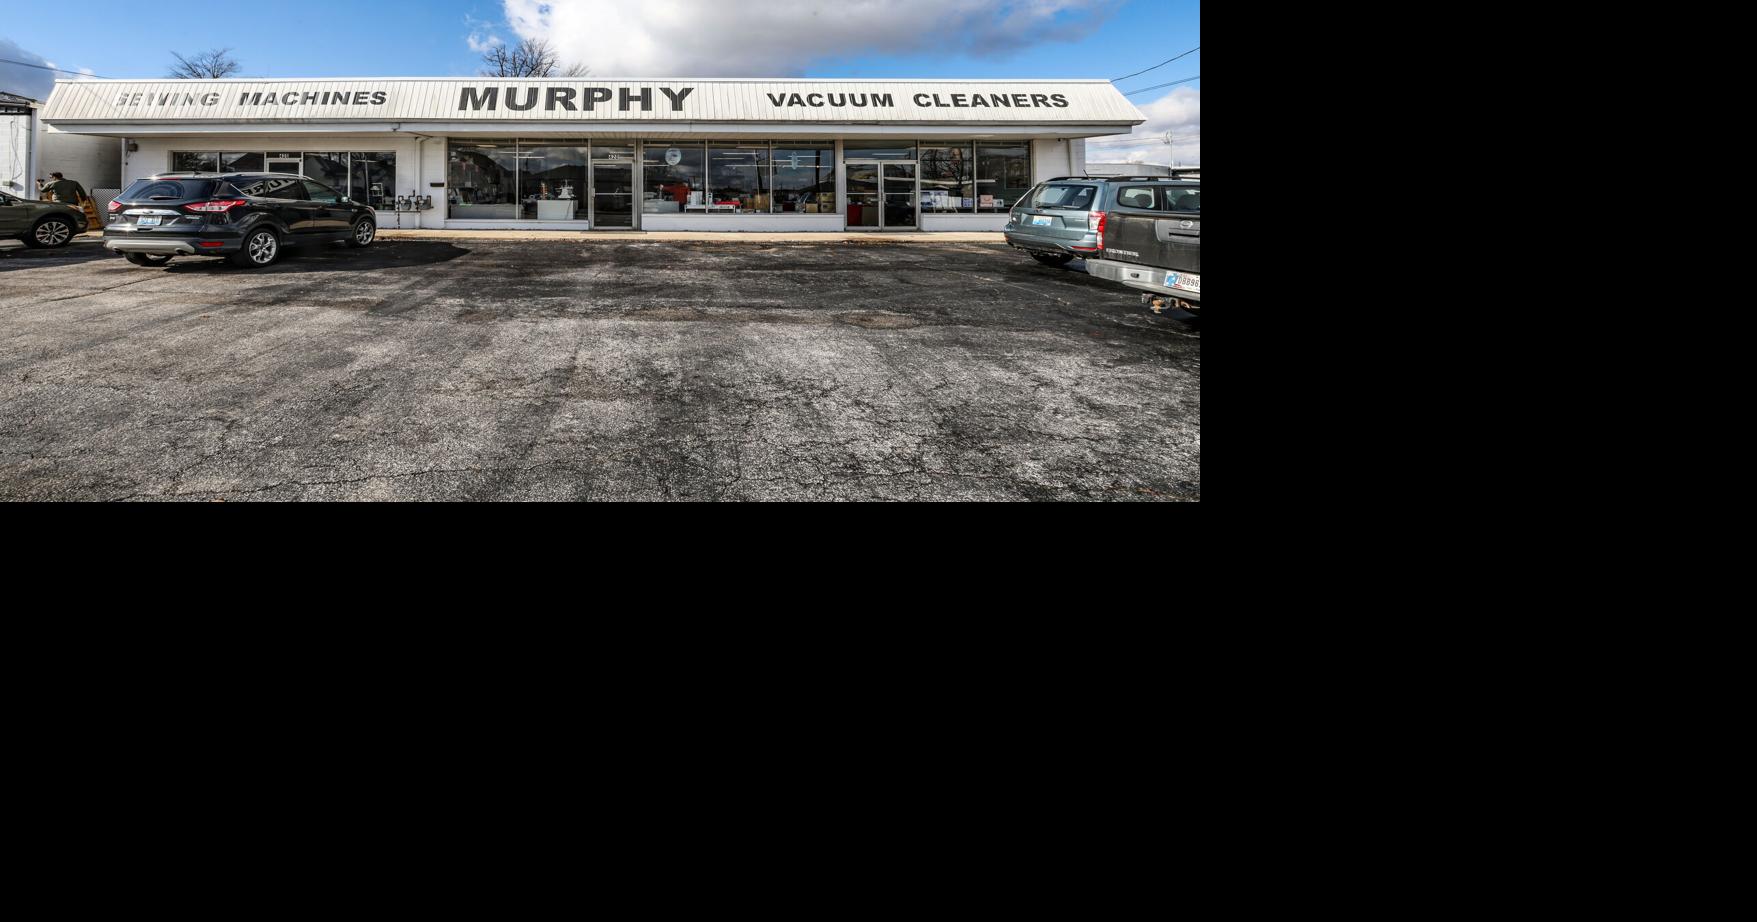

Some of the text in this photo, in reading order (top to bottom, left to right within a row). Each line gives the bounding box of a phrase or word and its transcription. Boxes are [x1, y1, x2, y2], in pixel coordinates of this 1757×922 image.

[116, 91, 388, 106] SEWING MACHINES
[458, 87, 694, 112] MURPHY
[766, 92, 1069, 108] VACUUM CLEANERS
